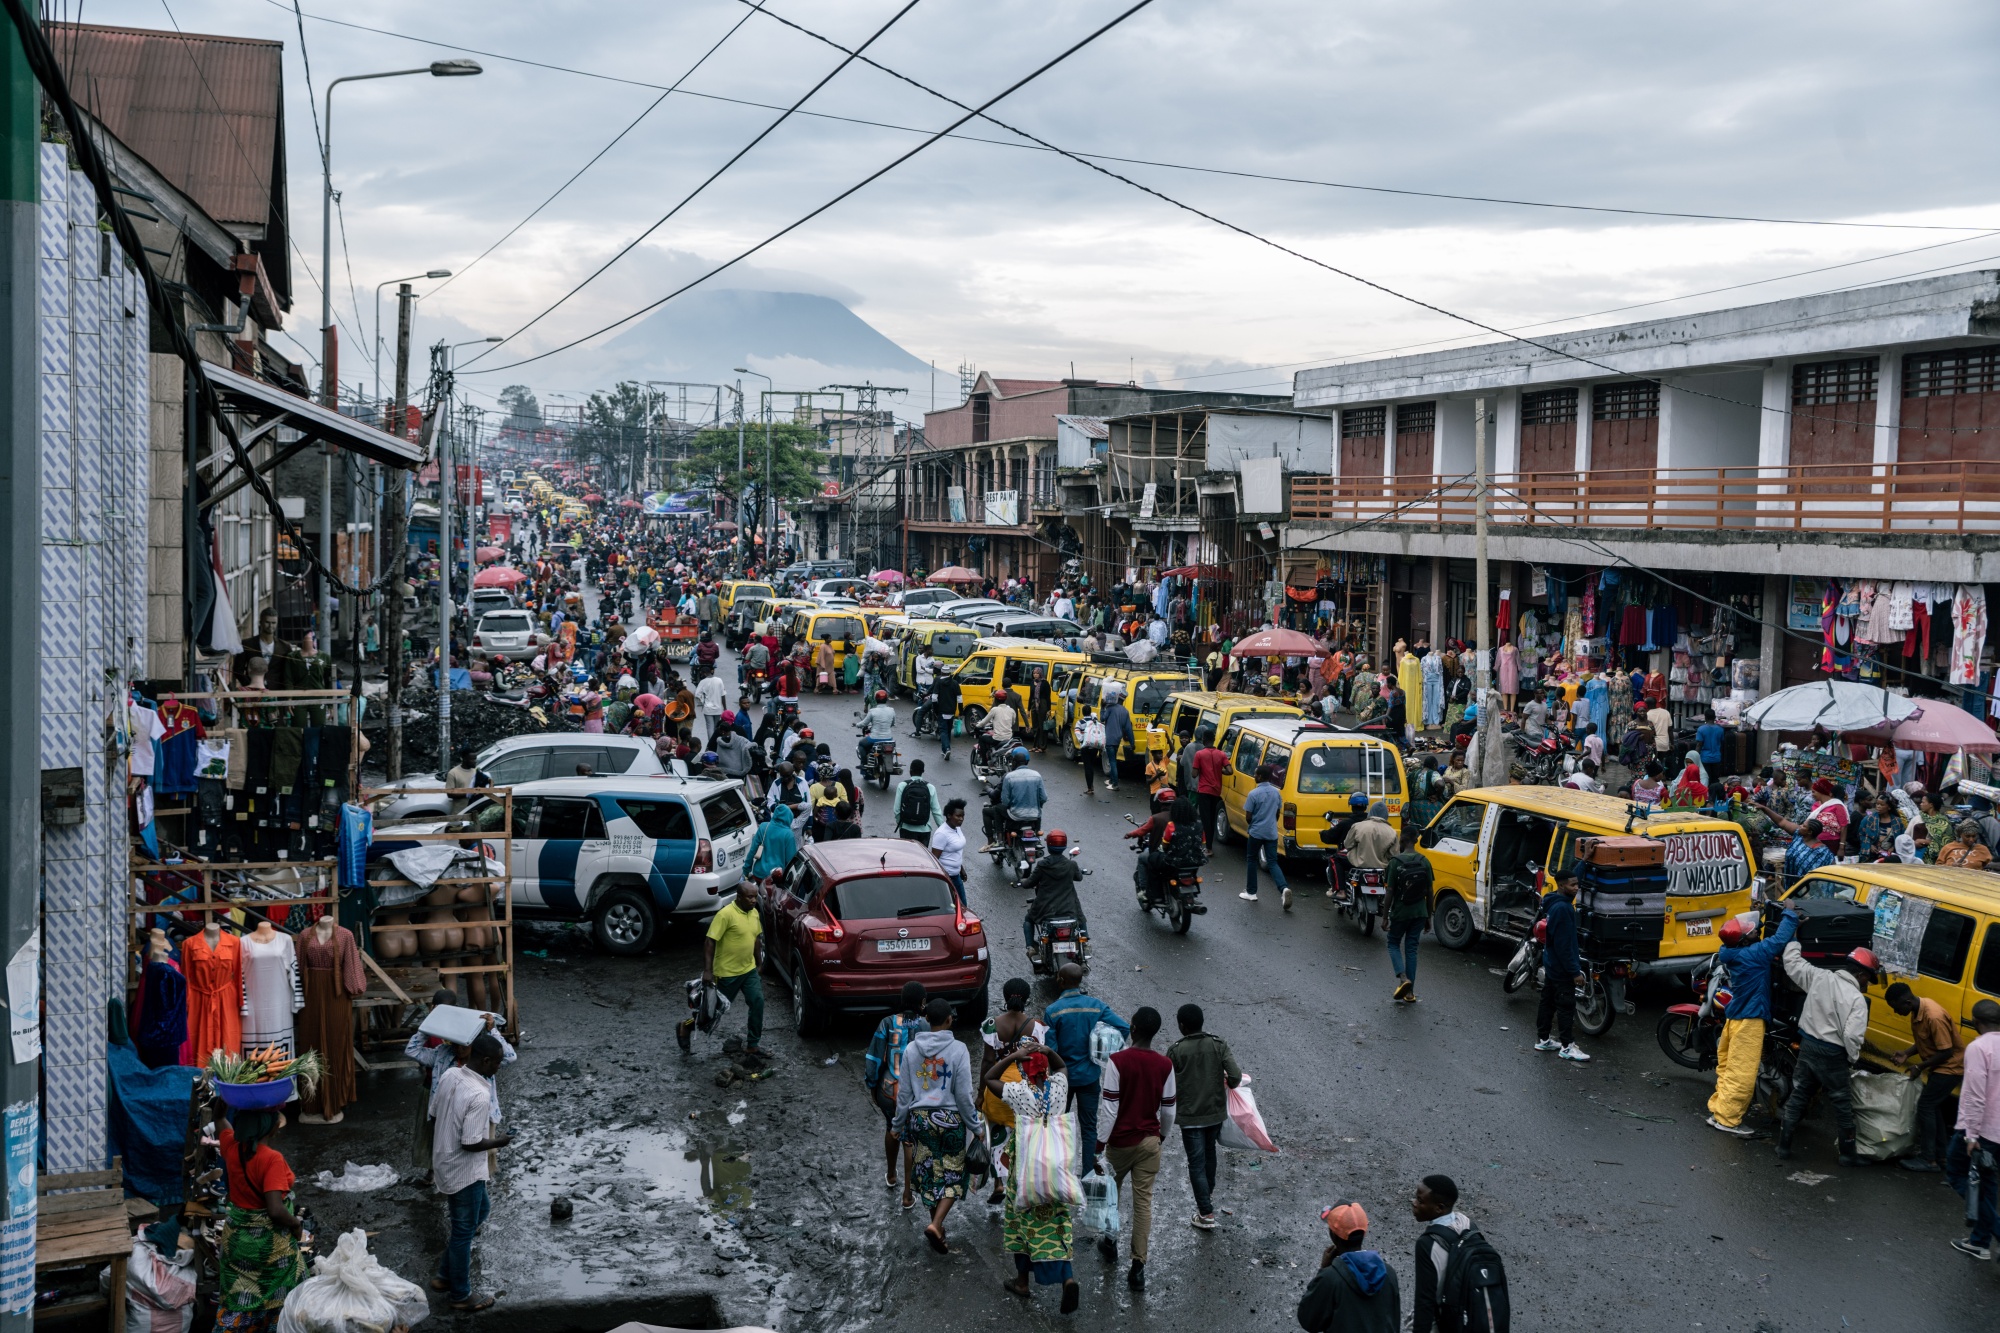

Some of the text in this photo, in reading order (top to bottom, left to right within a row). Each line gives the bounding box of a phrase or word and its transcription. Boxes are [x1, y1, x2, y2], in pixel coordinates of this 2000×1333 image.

[986, 491, 1015, 503] BEST PANT
[1910, 729, 1940, 738] airtel
[1665, 834, 1743, 865] ABIKUONE
[1683, 864, 1742, 893] WAKATI
[885, 939, 917, 950] 3549AG
[918, 939, 929, 950] 19
